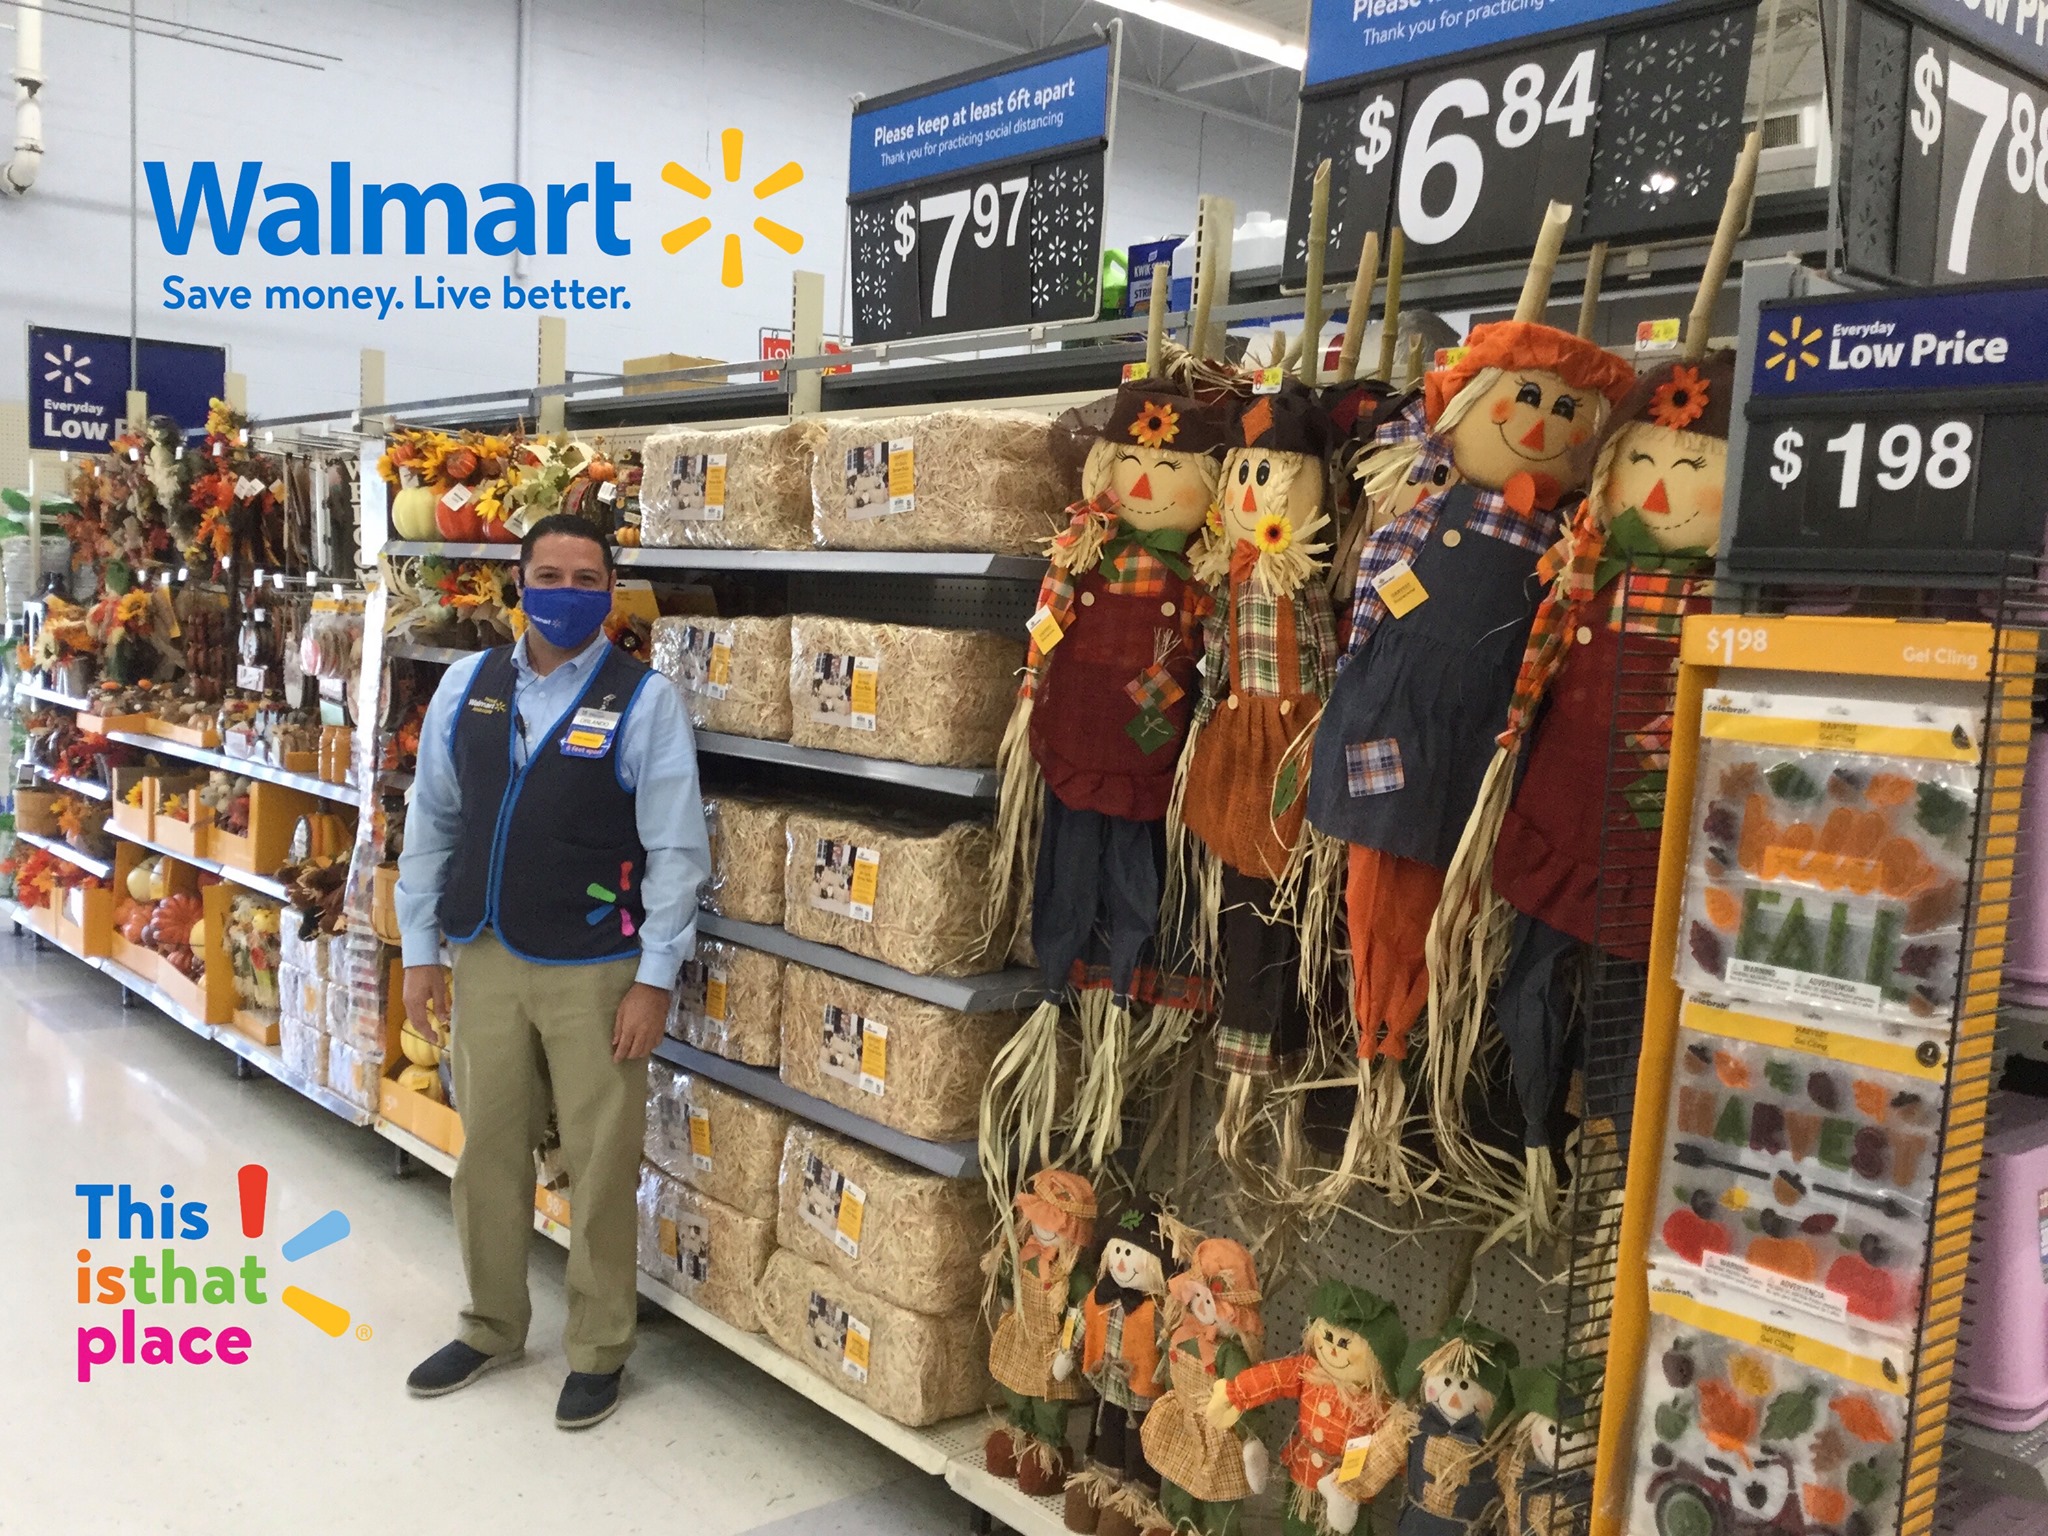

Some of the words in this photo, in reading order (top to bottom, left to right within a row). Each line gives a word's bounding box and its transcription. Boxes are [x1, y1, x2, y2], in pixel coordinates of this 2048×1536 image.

[1363, 22, 1406, 46] Thank
[1408, 16, 1436, 41] you
[1440, 10, 1463, 29] for
[874, 126, 915, 147] Please
[917, 114, 950, 137] keep
[952, 107, 967, 126] at
[970, 97, 1004, 121] least
[1007, 87, 1031, 112] 6ft
[1033, 77, 1076, 110] apart
[881, 151, 905, 167] Thank
[906, 147, 923, 165] you
[924, 142, 938, 157] for
[938, 131, 984, 156] practicing
[985, 123, 1012, 142] social
[1013, 111, 1064, 135] distancing
[1832, 320, 1896, 338] Everyday
[1828, 338, 1905, 371] Low
[1910, 330, 2008, 366] Price
[44, 399, 104, 416] Everyday
[44, 412, 109, 440] Low
[1902, 646, 1930, 663] Gel
[1934, 647, 1978, 669] Cling
